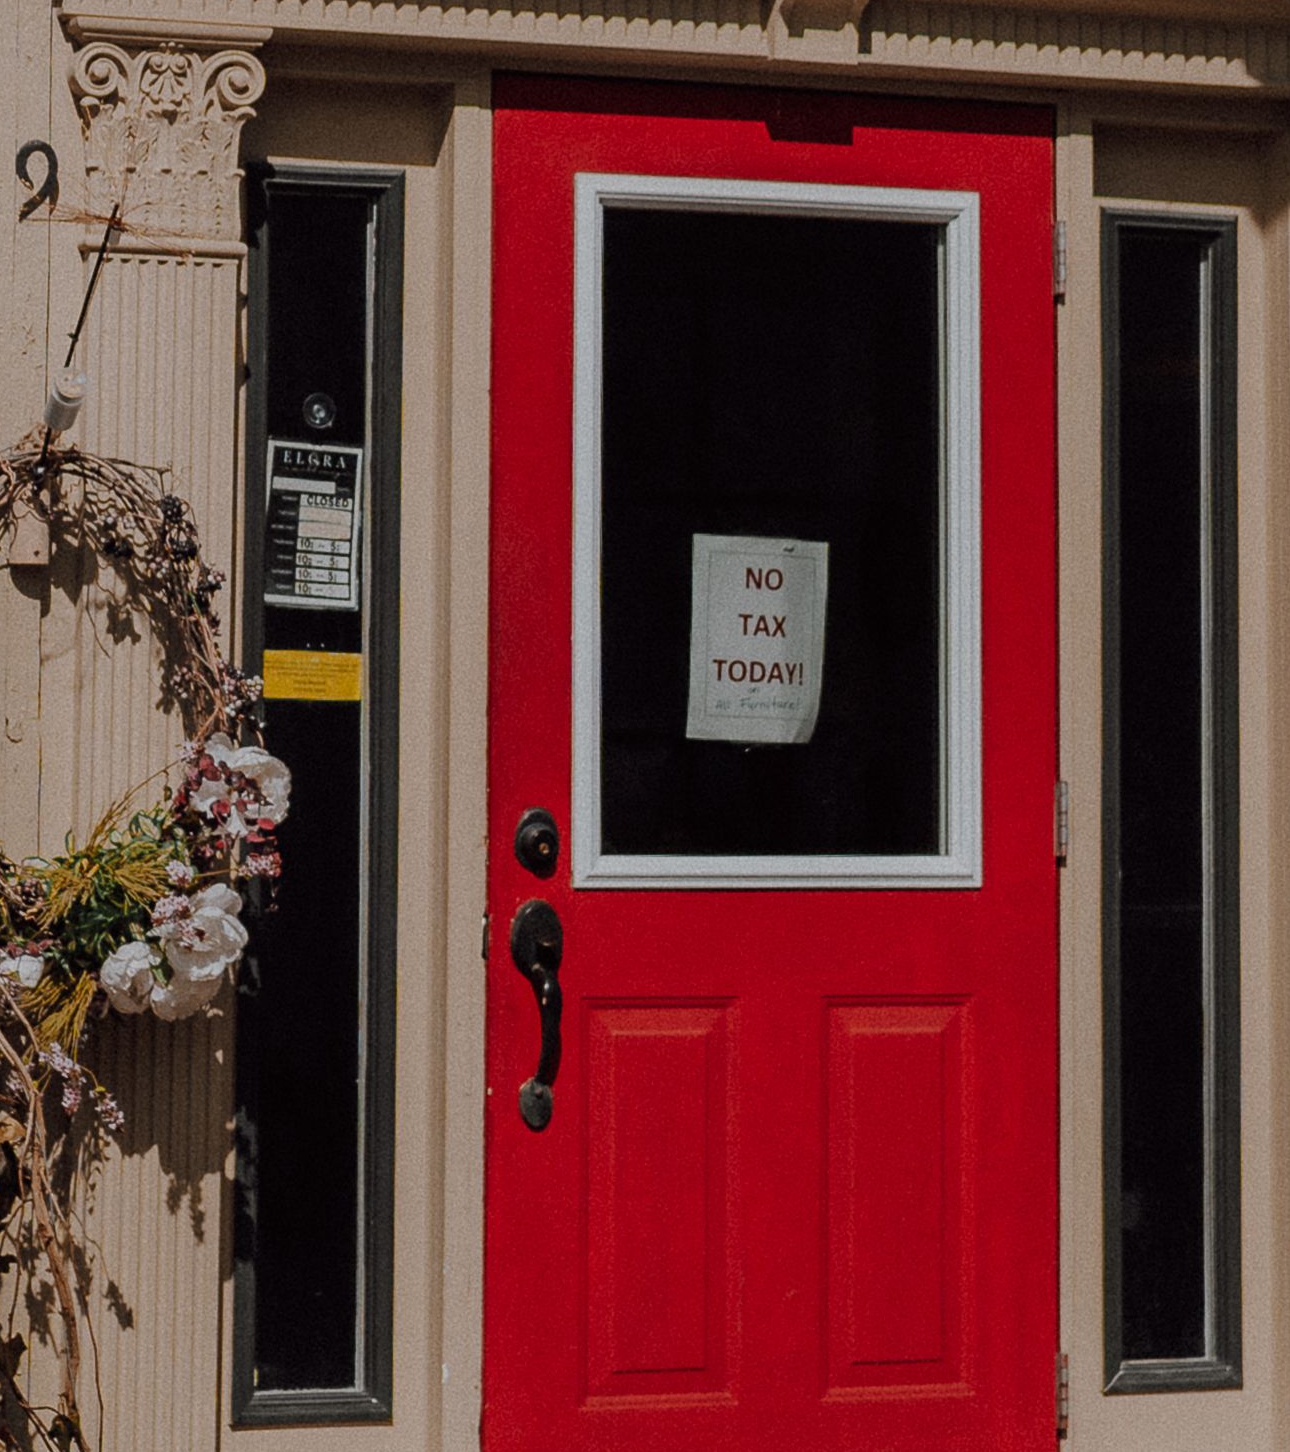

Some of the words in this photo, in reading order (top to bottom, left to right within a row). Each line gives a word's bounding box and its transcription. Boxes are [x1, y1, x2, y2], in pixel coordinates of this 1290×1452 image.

[307, 494, 349, 508] CLOSED
[745, 567, 784, 591] NO
[738, 613, 787, 639] TAX
[712, 659, 804, 687] TODAY!
